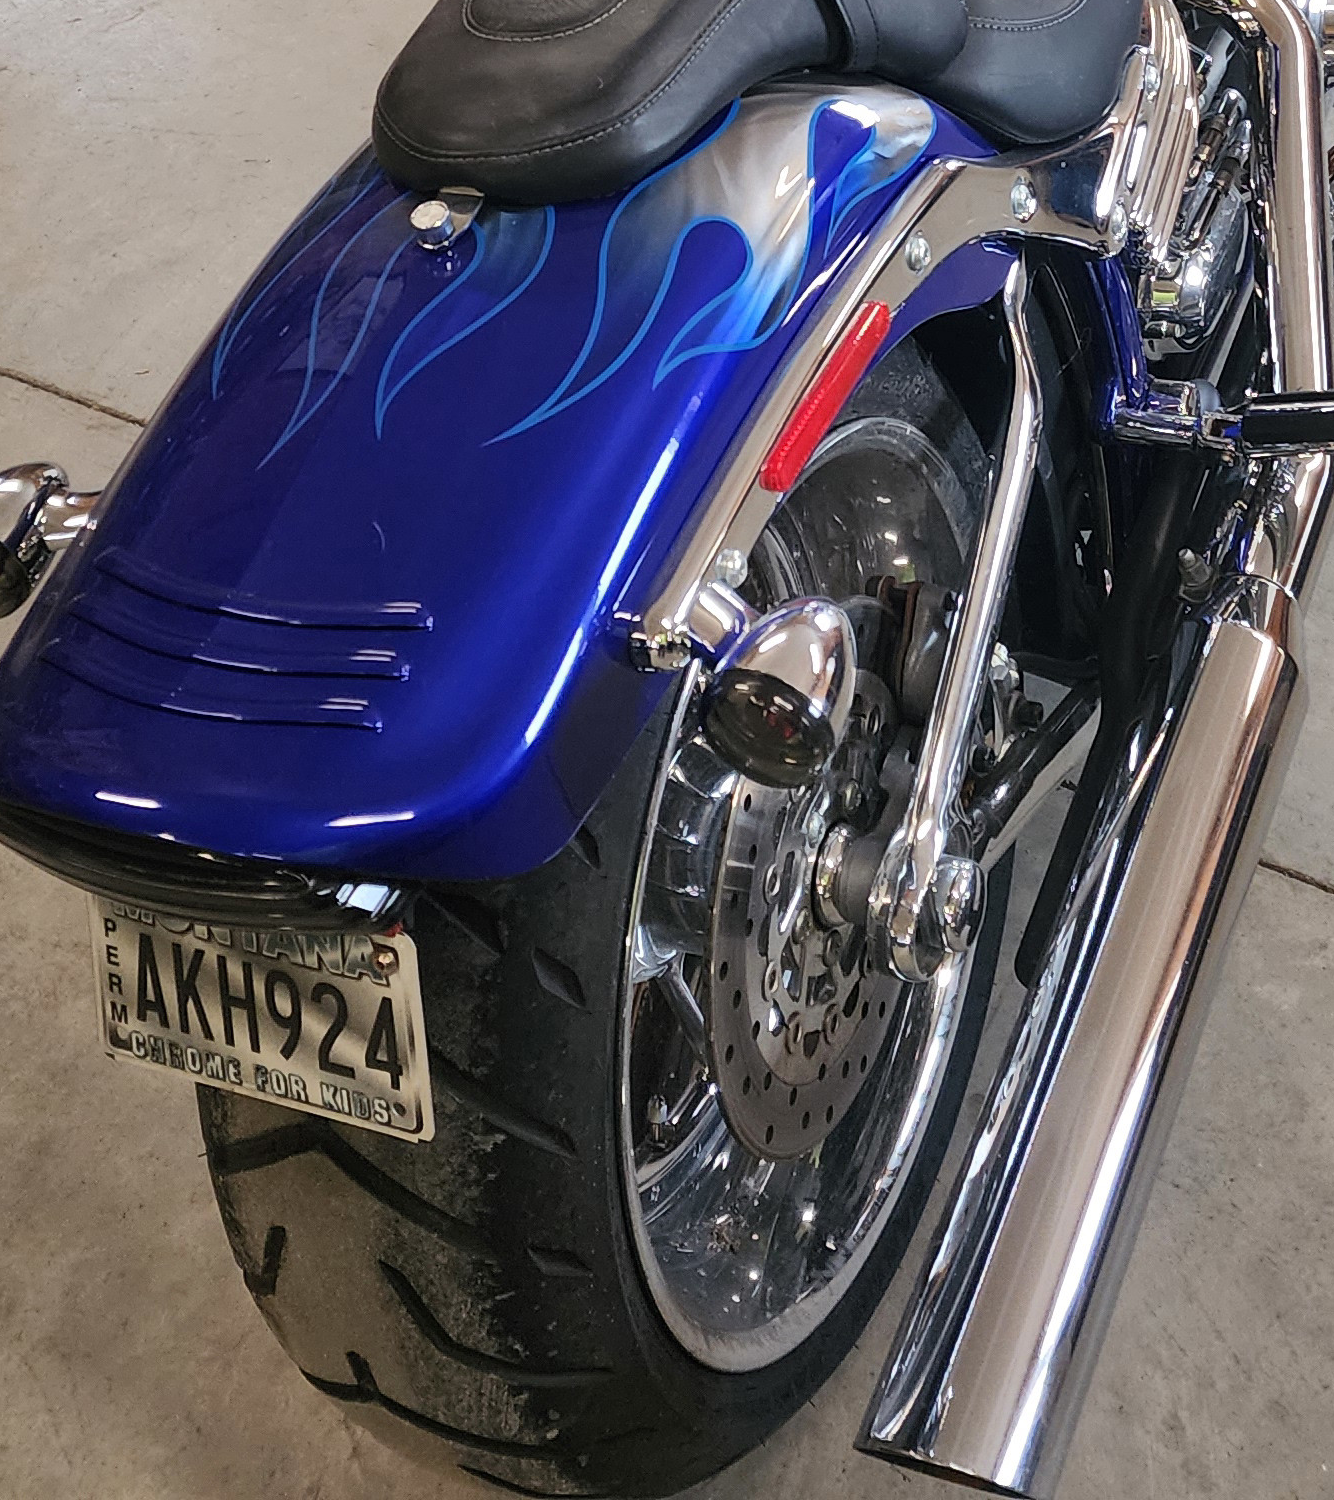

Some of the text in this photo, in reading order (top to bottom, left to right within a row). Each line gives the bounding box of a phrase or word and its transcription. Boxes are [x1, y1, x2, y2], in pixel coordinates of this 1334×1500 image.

[103, 916, 129, 1026] PERM
[135, 931, 404, 1092] AKH924
[129, 1029, 393, 1127] CHROME FOR KIDS
